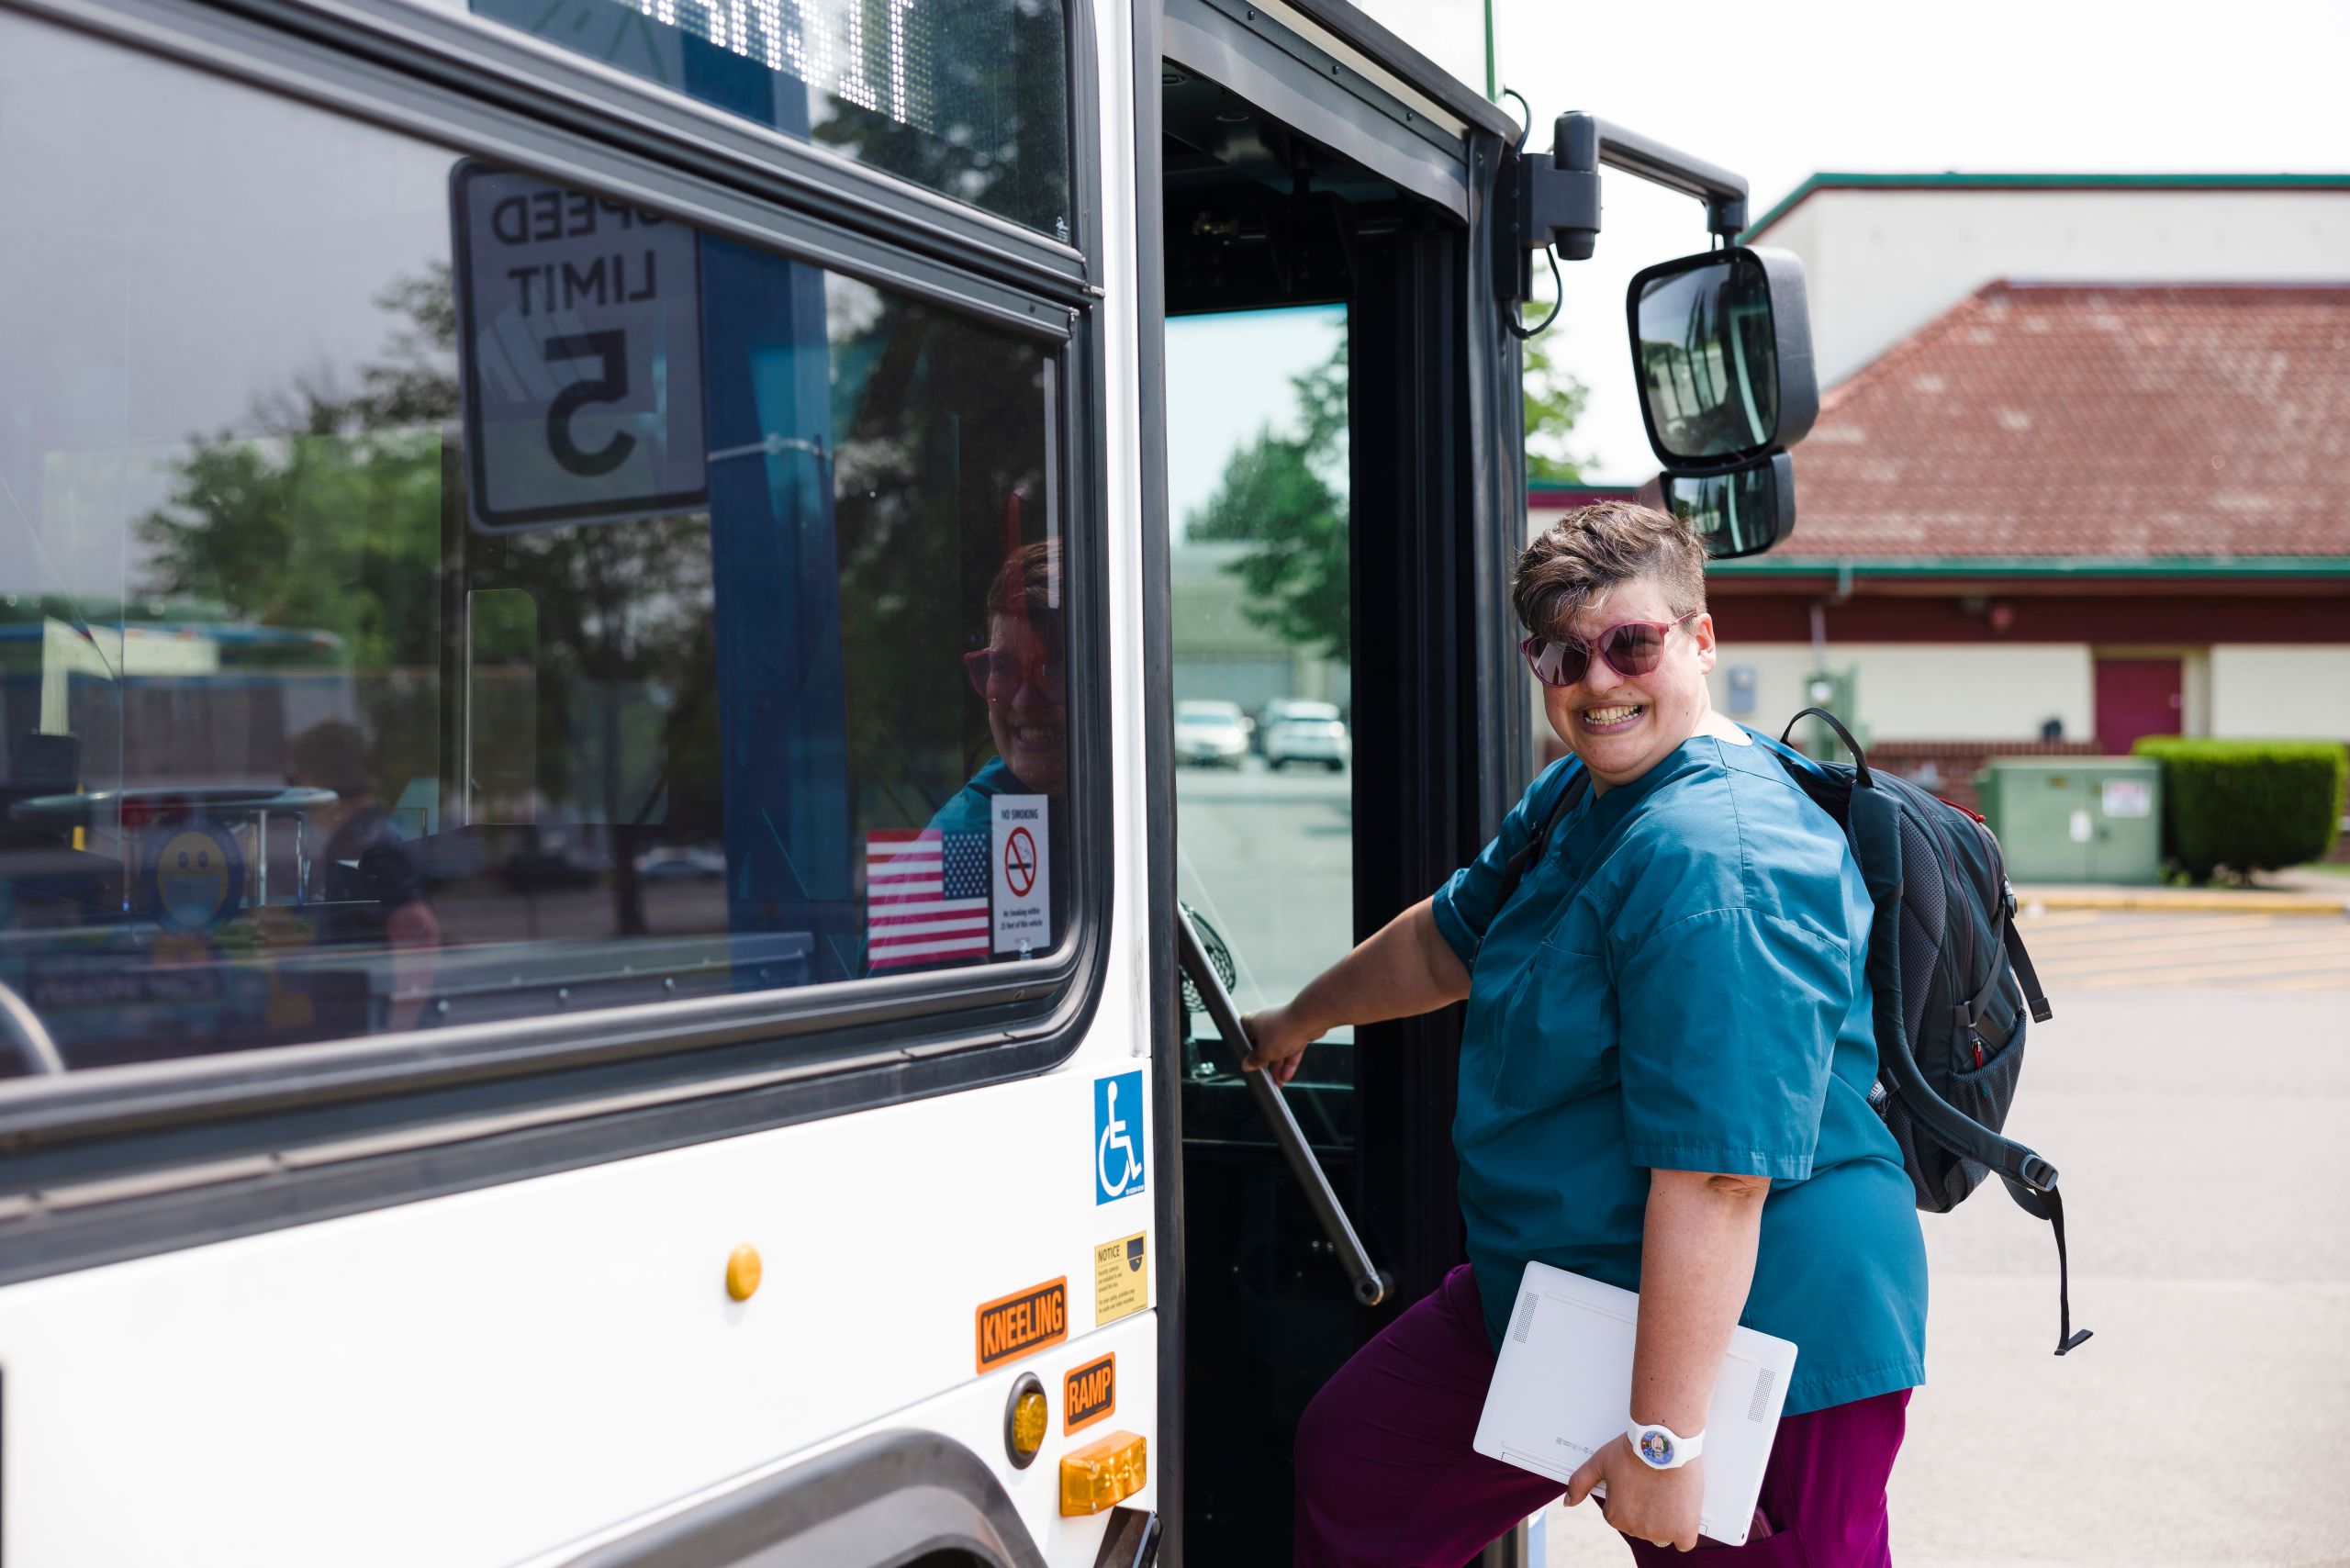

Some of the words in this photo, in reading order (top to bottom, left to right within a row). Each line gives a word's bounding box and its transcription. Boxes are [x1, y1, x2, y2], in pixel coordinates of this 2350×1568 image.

[1001, 809, 1010, 820] NO
[1012, 808, 1038, 820] SMOKING
[1098, 1244, 1120, 1263] NOTICE
[983, 1290, 1063, 1358] KNEELING
[1069, 1365, 1111, 1417] RAMP
